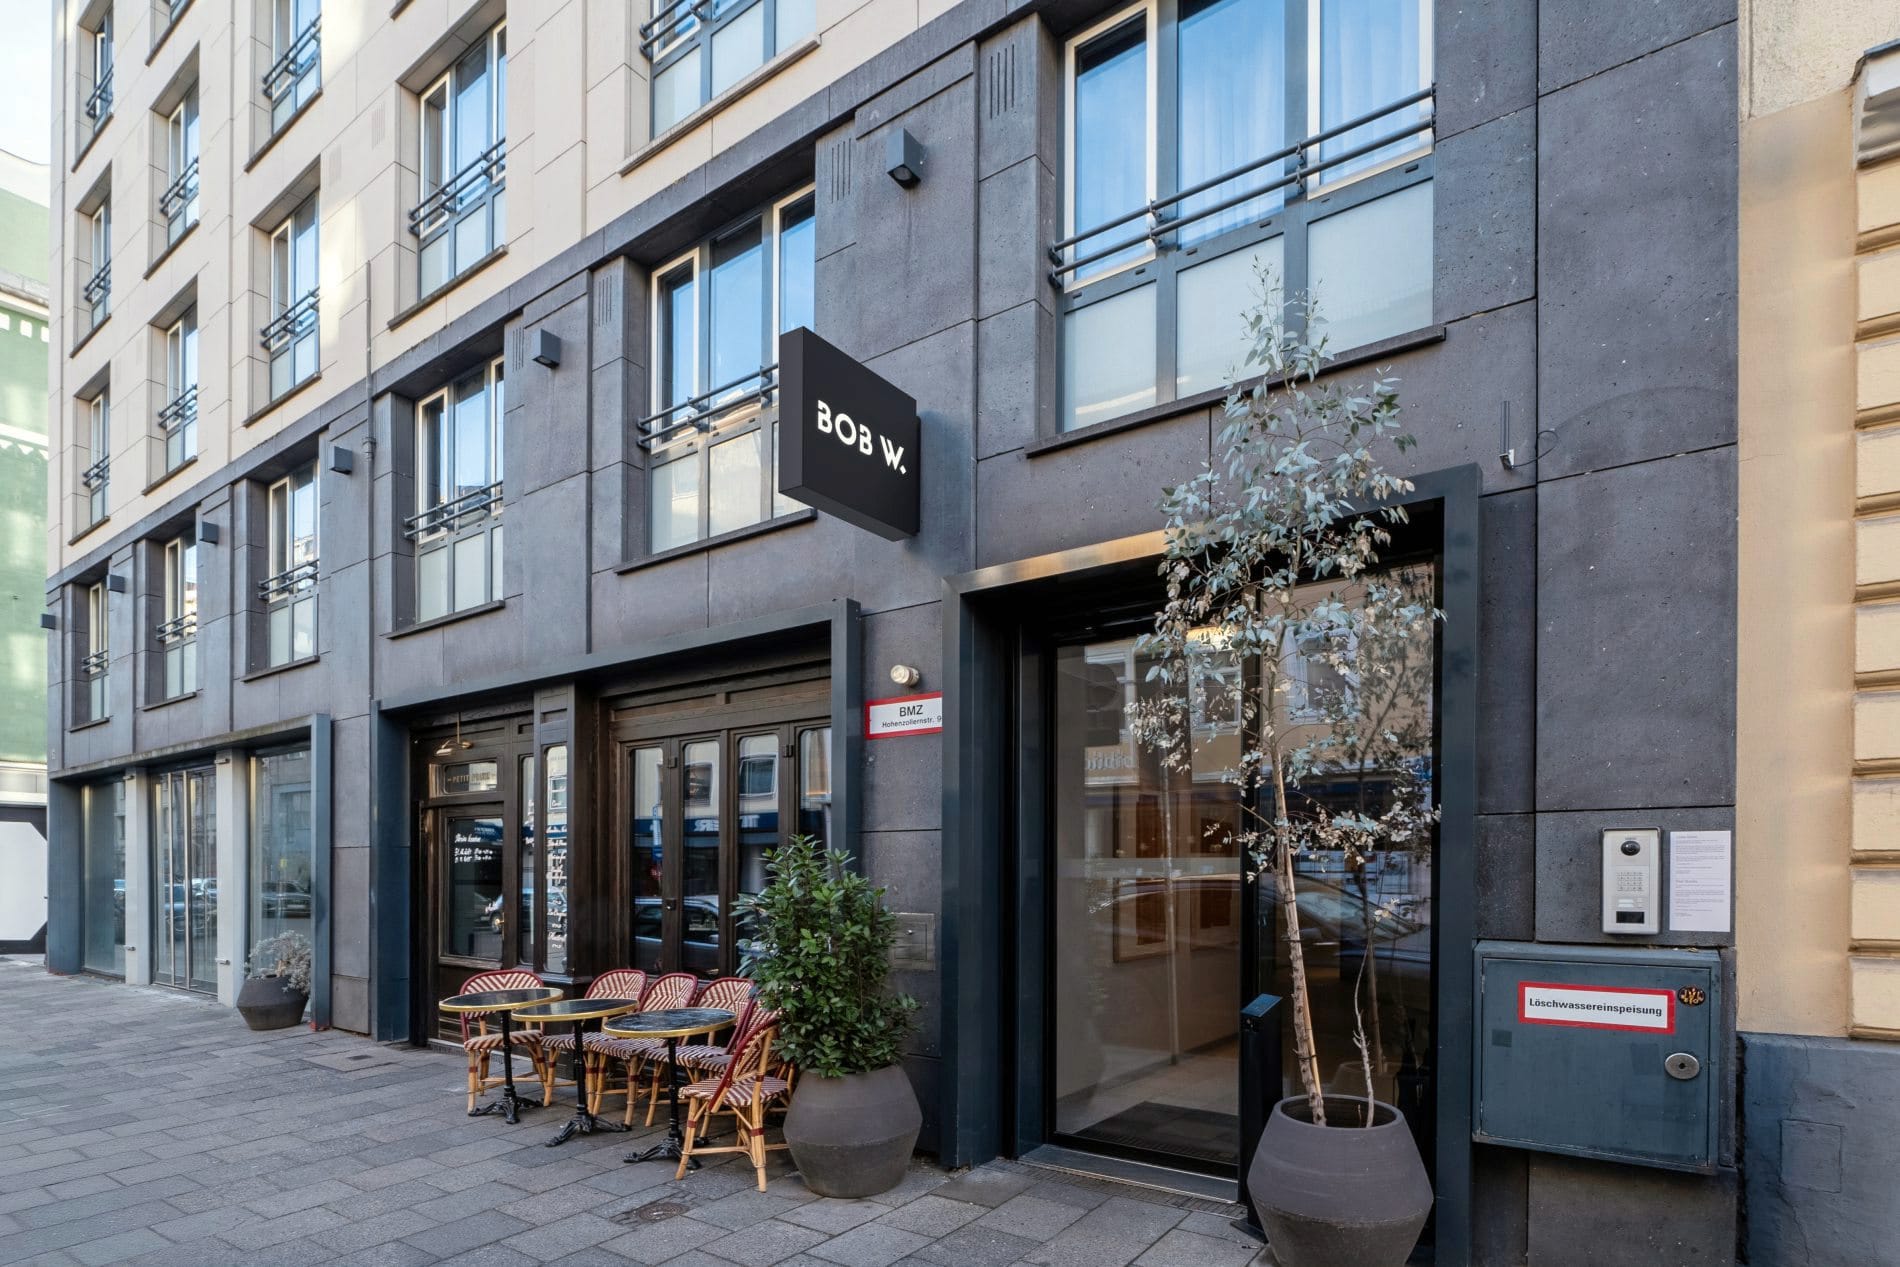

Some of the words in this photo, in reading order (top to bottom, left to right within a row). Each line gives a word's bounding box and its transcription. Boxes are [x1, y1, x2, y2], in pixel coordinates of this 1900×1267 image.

[817, 399, 873, 456] BOB
[879, 434, 907, 475] W.
[899, 704, 923, 717] BMZ
[881, 716, 935, 728] Hohenzollernstr.
[1529, 998, 1663, 1017] Löschwassereinspeisung
